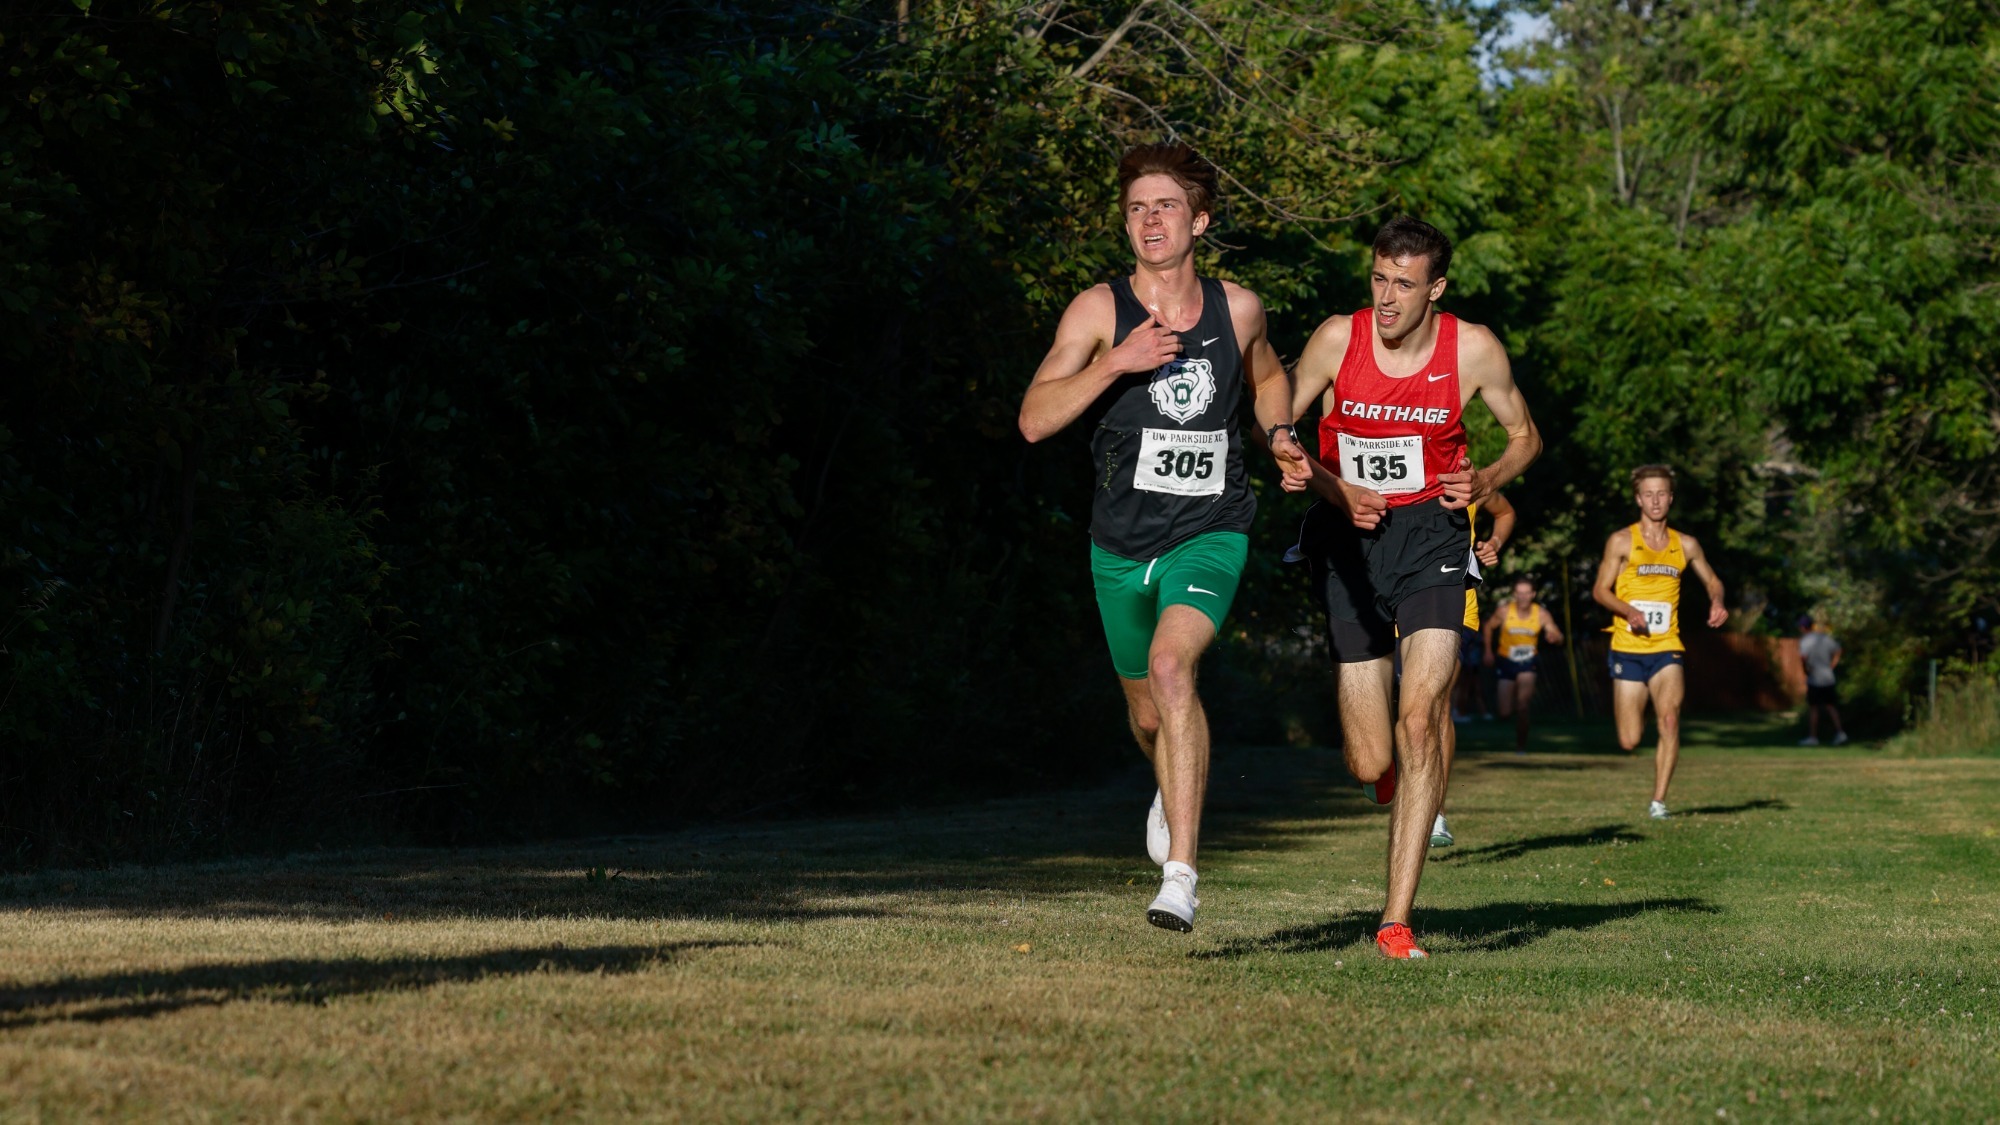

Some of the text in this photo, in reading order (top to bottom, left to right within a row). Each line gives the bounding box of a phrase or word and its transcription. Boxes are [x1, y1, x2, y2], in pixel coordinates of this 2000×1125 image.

[1341, 399, 1451, 424] CARTHAGE
[1152, 431, 1224, 444] UW-PARKSIDE XC
[1345, 436, 1414, 450] UW-PARKSIDE XC
[1154, 450, 1214, 479] 305
[1352, 454, 1408, 481] 135
